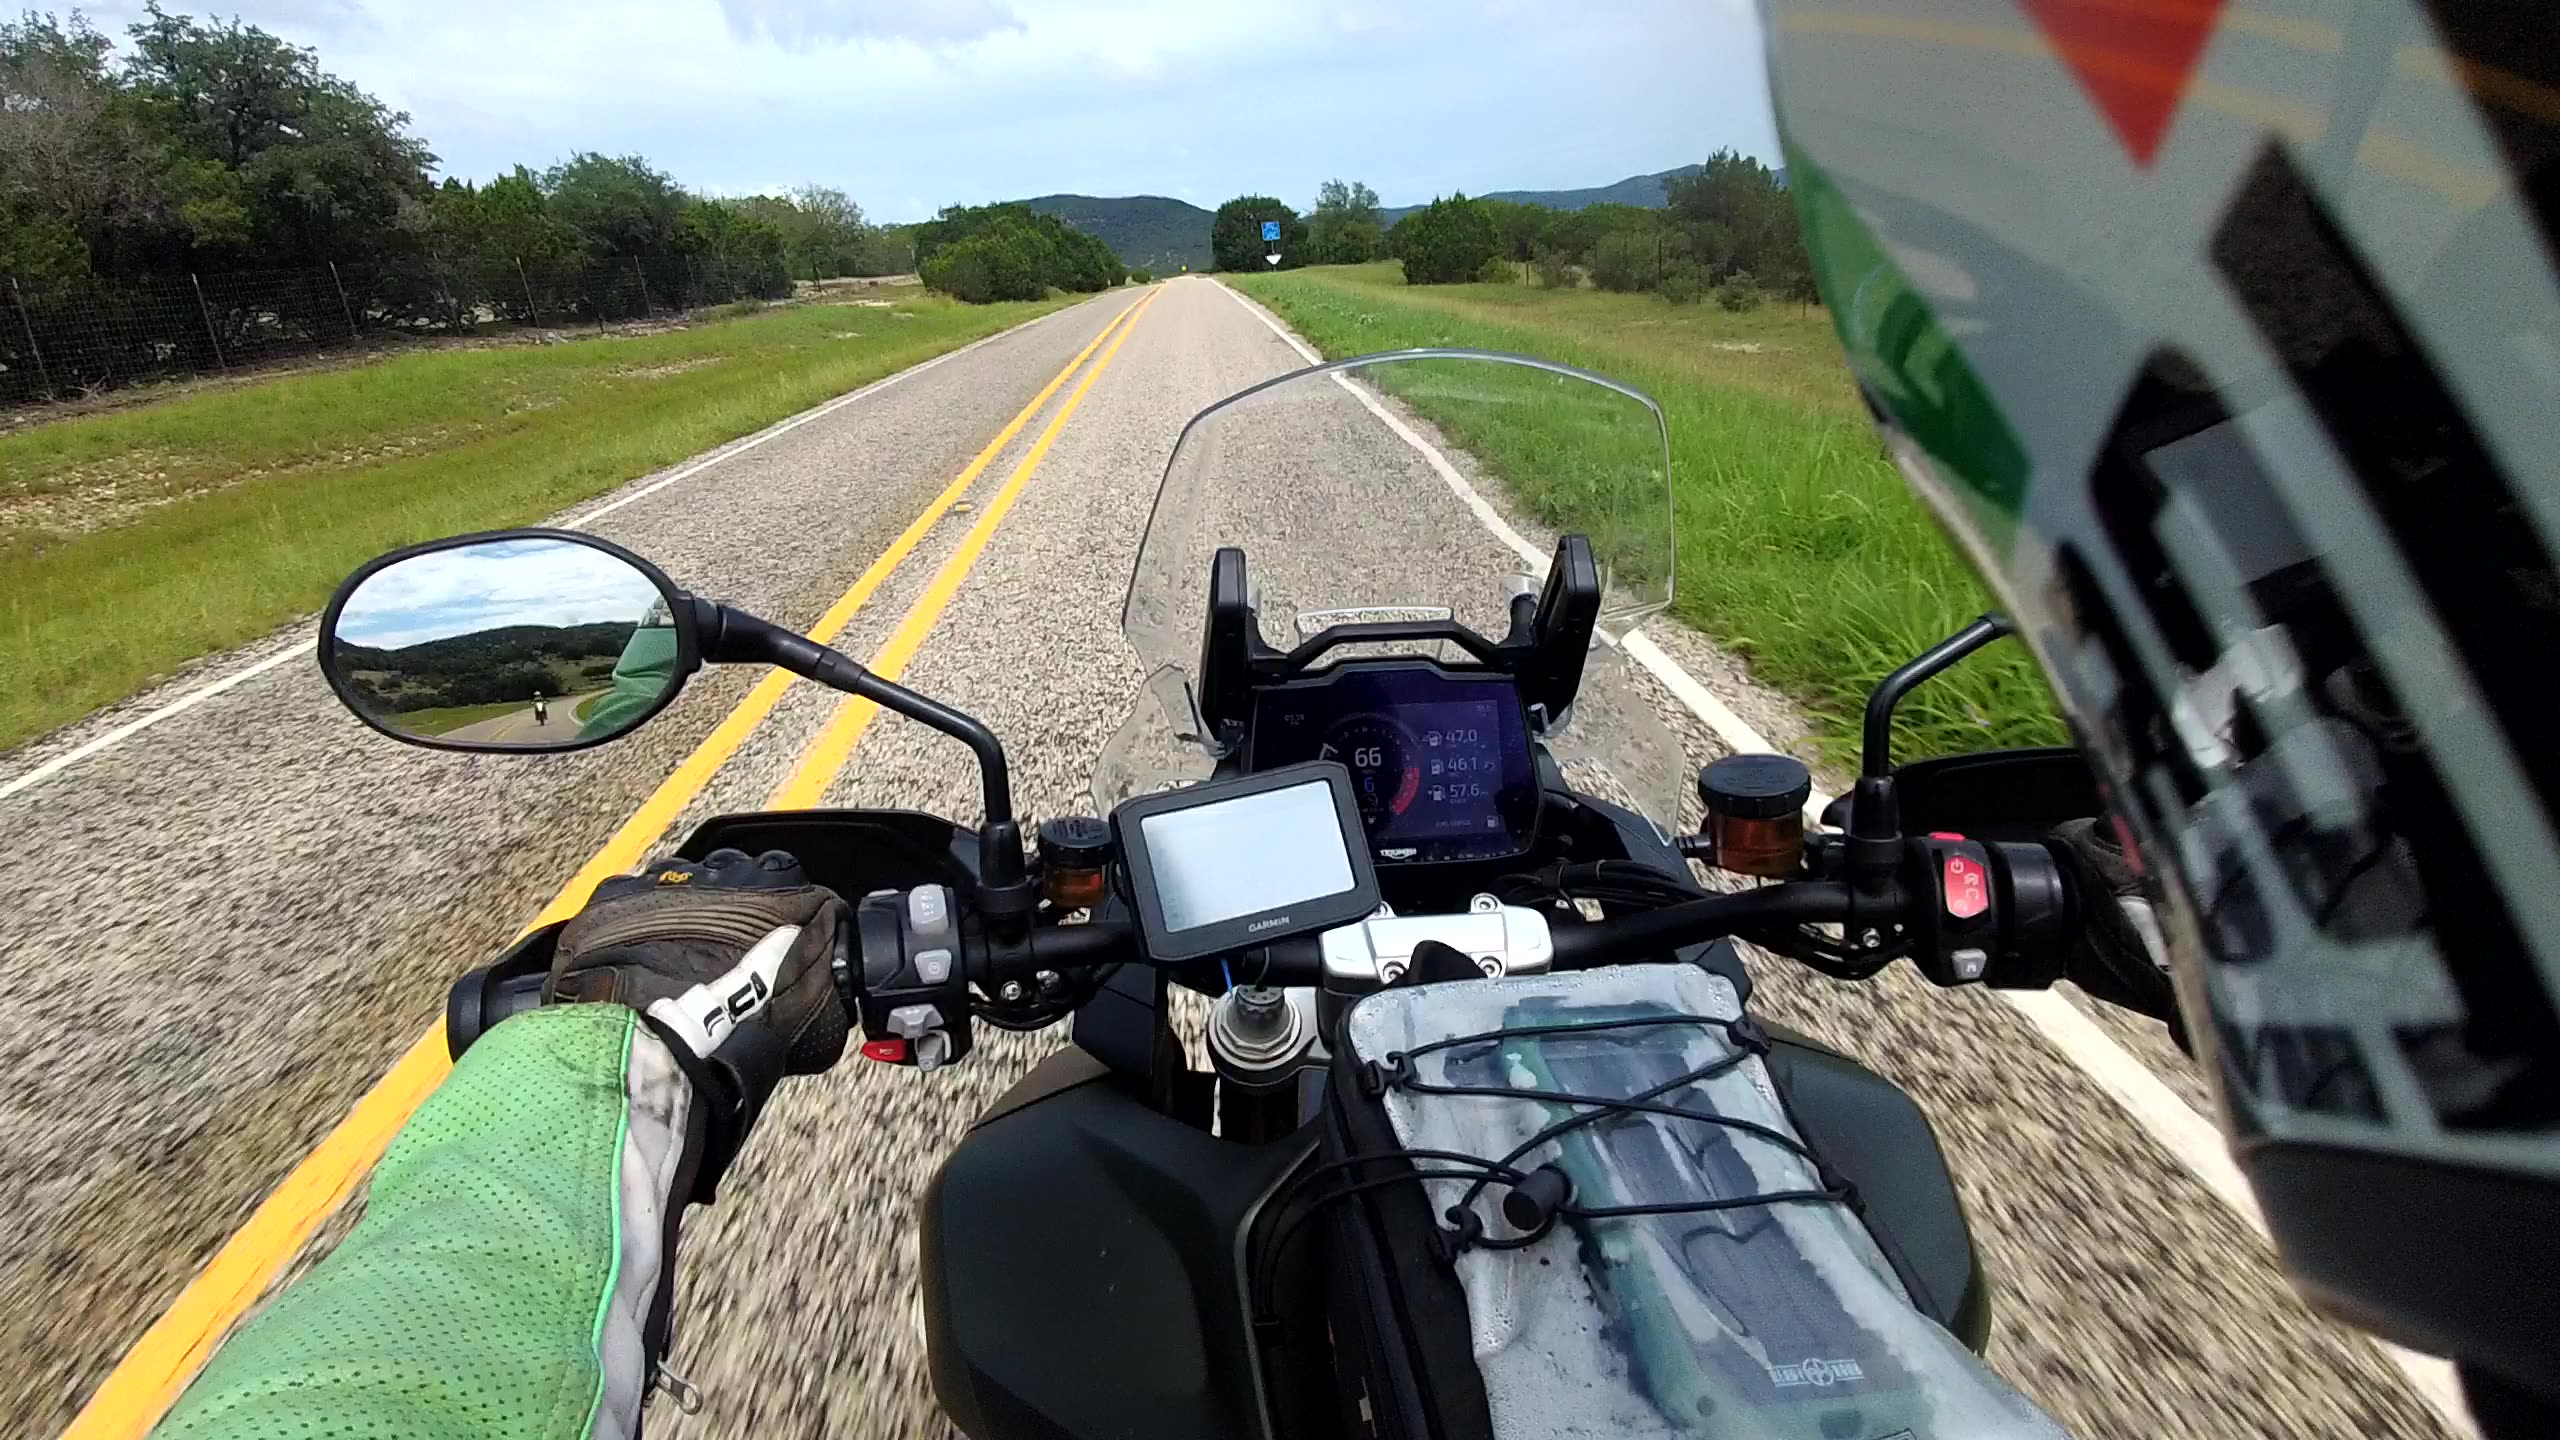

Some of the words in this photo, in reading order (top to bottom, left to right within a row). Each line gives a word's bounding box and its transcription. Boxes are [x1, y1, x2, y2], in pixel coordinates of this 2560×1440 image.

[1446, 729, 1478, 743] 47.0
[1355, 747, 1382, 768] 66
[1448, 757, 1478, 771] 46.1
[1364, 777, 1375, 793] 6
[1449, 783, 1480, 797] 57.6
[1248, 916, 1290, 933] GARMIN
